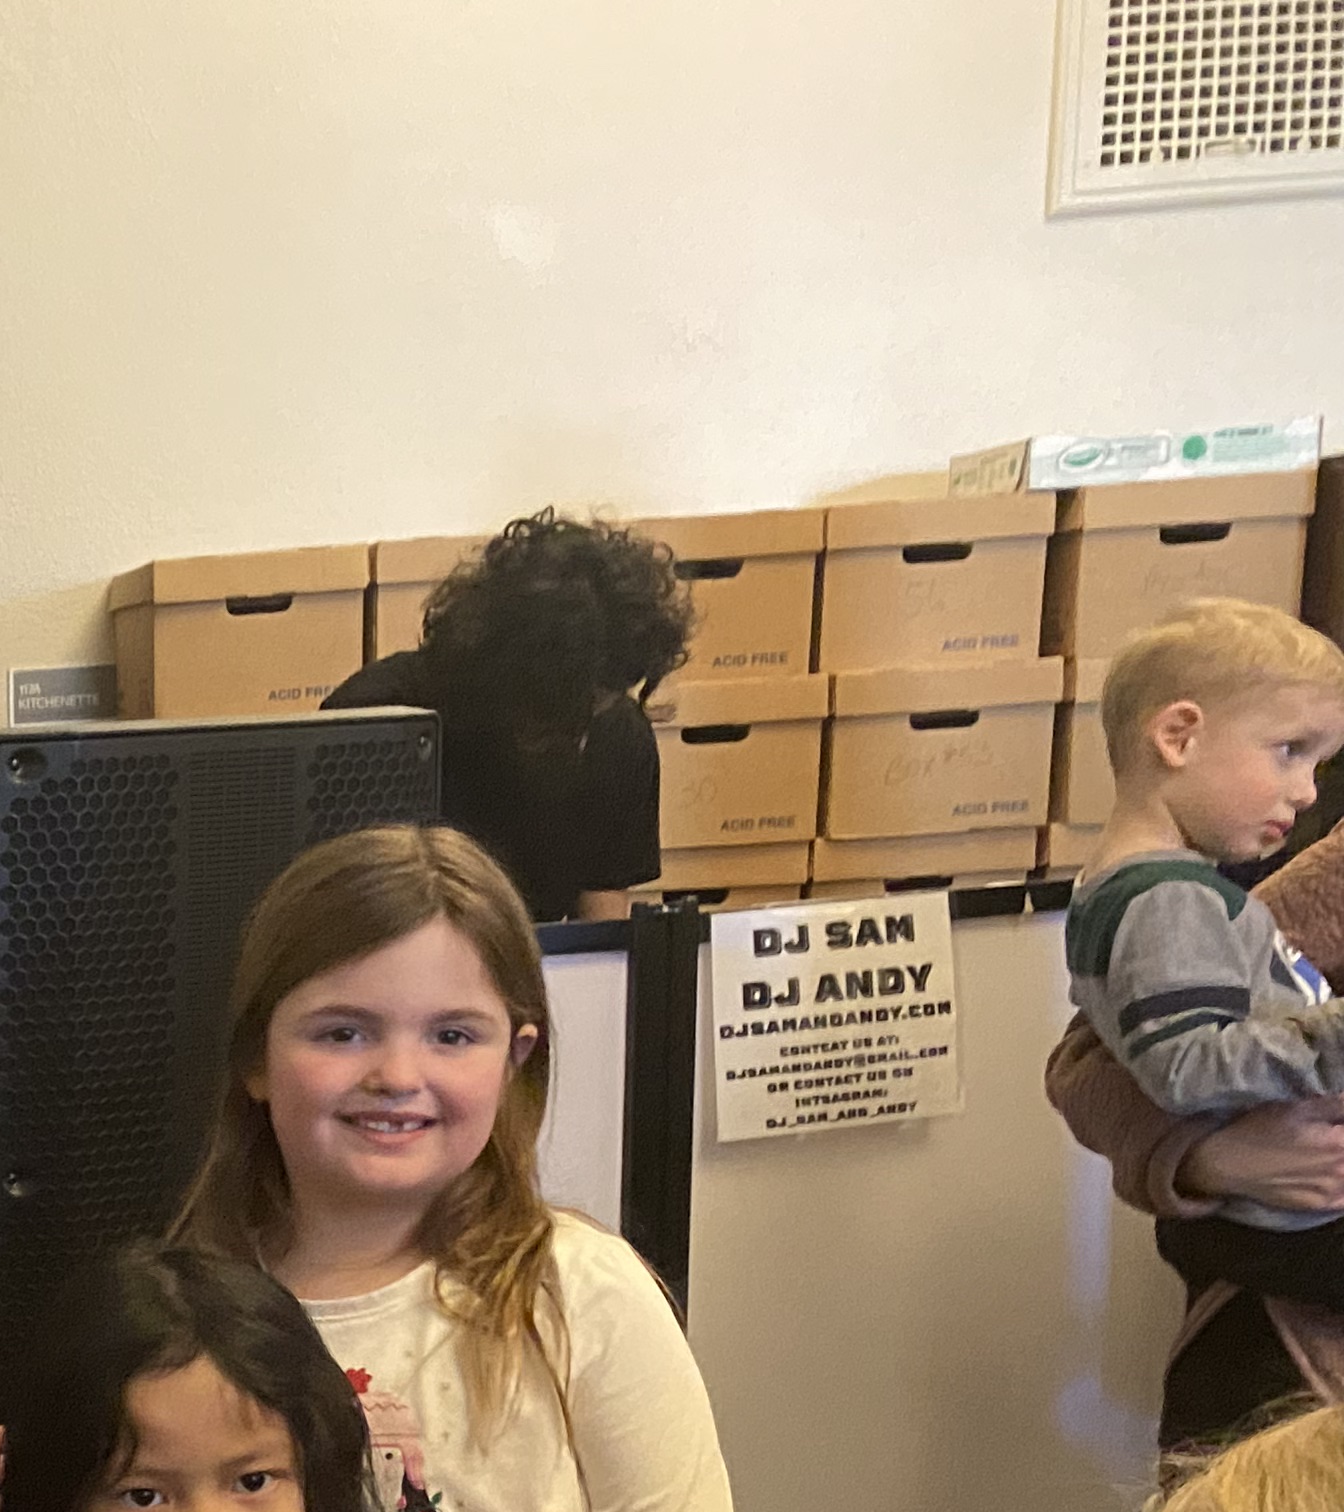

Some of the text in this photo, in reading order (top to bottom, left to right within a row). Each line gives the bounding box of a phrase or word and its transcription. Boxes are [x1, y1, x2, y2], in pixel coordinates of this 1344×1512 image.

[981, 633, 1019, 650] FREE
[712, 651, 788, 668] ACID FREE
[268, 683, 339, 701] ACID FRE
[17, 693, 100, 710] KITCHENETTE
[952, 799, 1029, 817] ACID FREE
[720, 815, 796, 832] ACID FREE
[753, 914, 915, 958] DJ SAM
[742, 963, 932, 1010] DJ ANDY
[719, 1000, 951, 1040] DJSAMANDANDY.COM
[852, 1037, 873, 1049] US
[767, 1066, 915, 1094] OR CONTACT US ON
